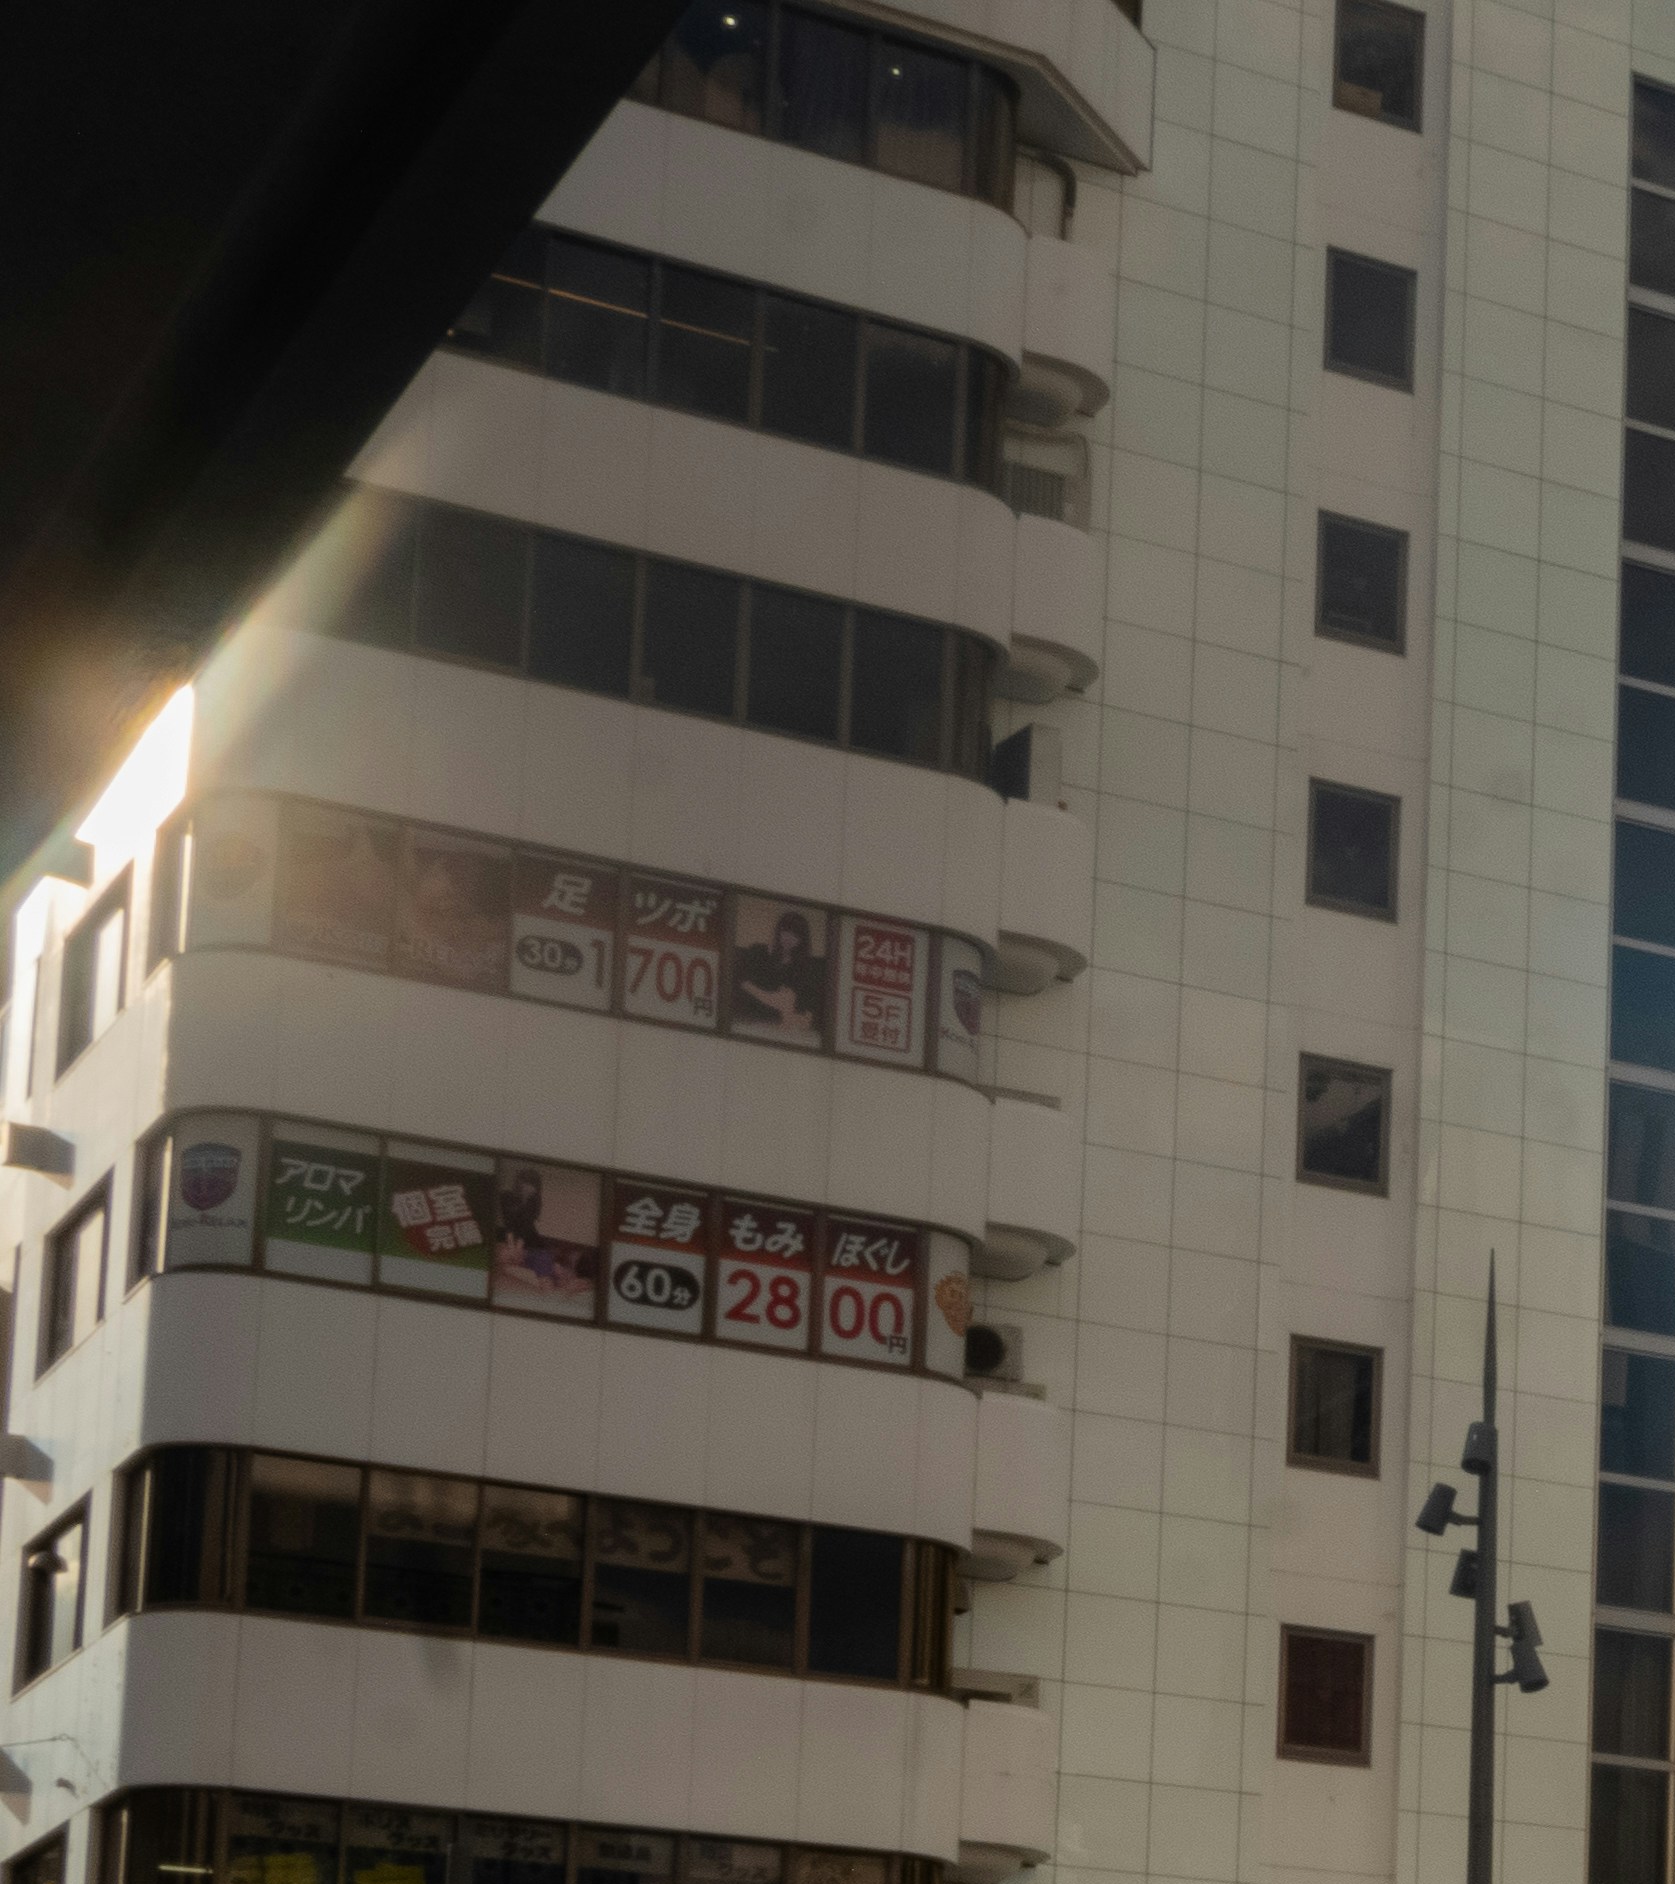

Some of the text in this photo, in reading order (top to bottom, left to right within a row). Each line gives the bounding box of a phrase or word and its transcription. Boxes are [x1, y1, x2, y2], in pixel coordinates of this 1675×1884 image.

[545, 873, 716, 932] 足 ツボ
[858, 934, 911, 964] 24H
[862, 995, 901, 1024] 5F
[276, 1157, 364, 1195] アロマ
[391, 1185, 468, 1228] 個室
[619, 1198, 910, 1275] 全身 もみ ほぐし
